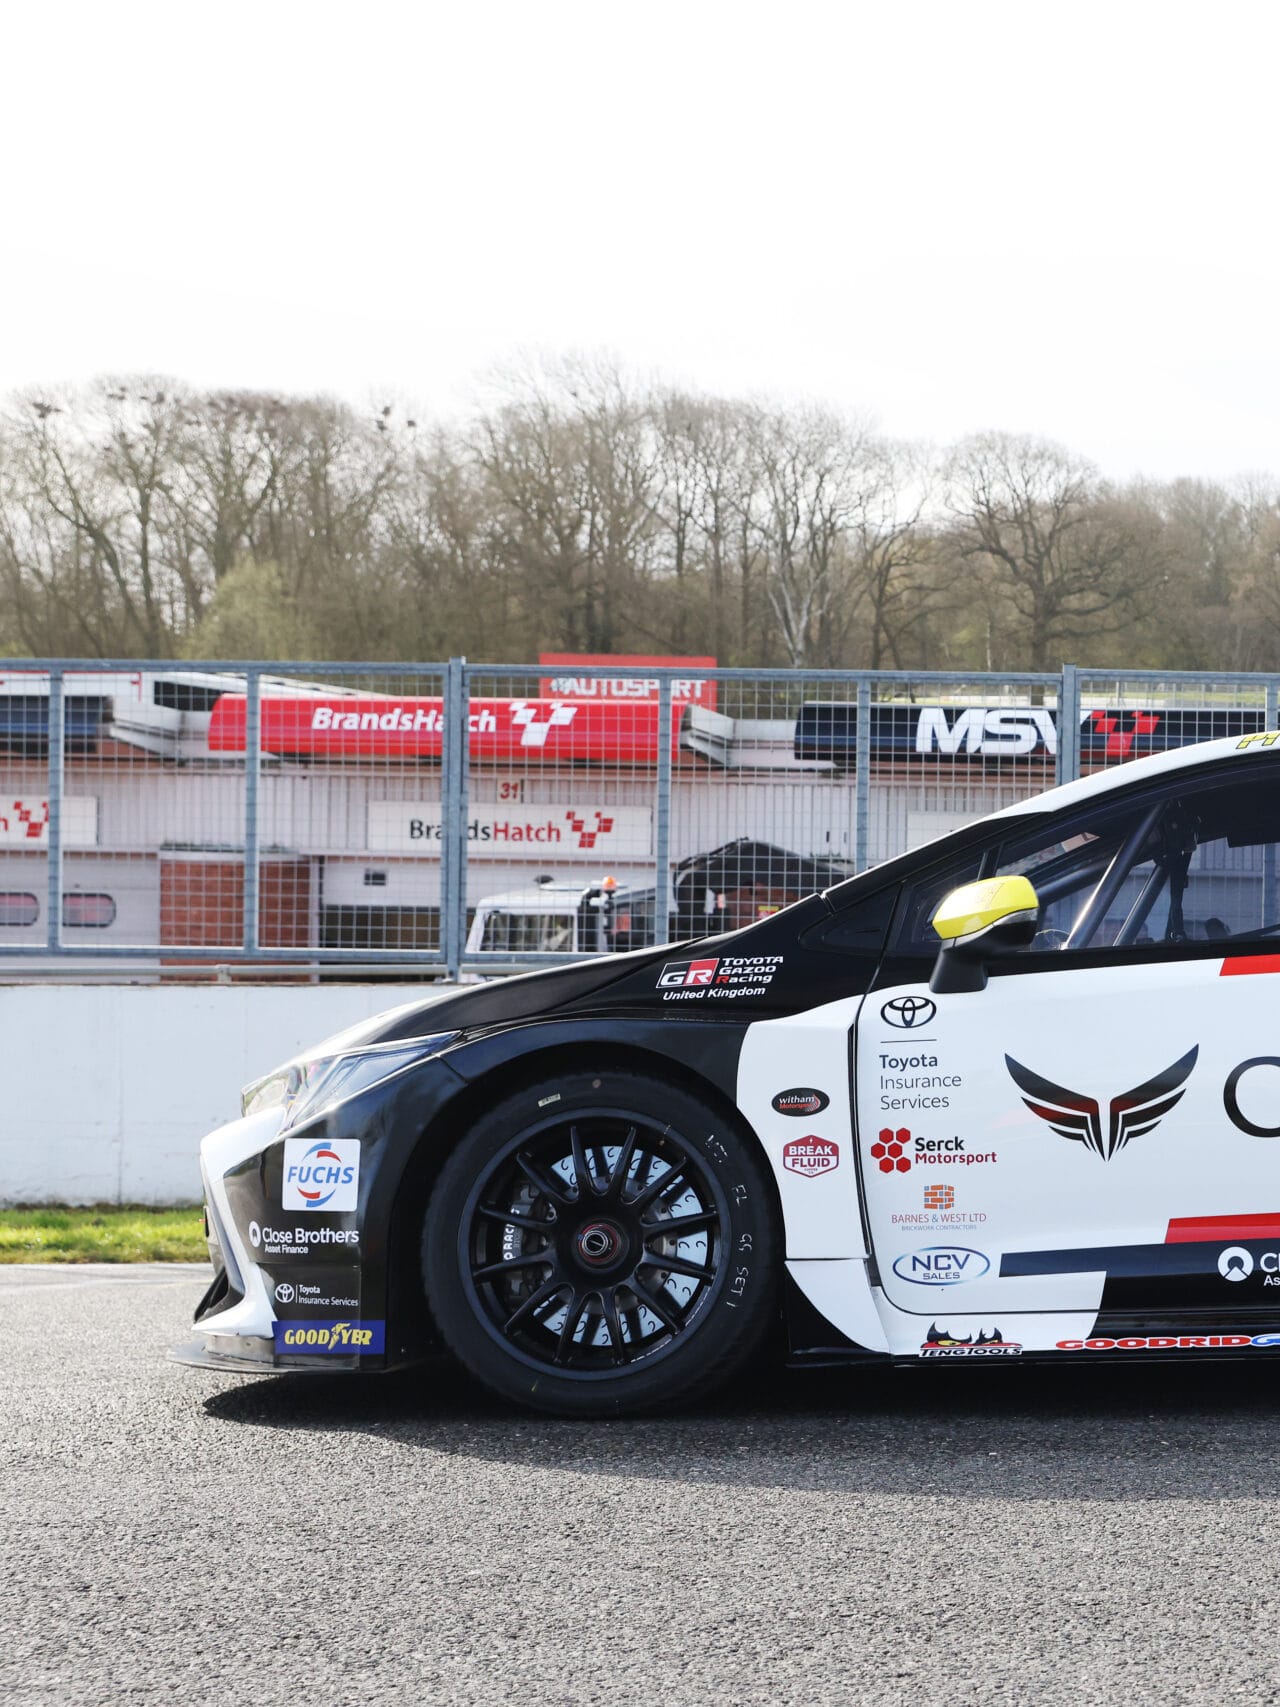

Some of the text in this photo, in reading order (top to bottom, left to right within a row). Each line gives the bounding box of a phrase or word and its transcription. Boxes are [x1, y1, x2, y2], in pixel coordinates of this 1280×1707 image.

[567, 678, 707, 698] AUTOSPRT
[721, 956, 784, 966] TOYOTA
[719, 965, 777, 975] GAZOO
[660, 969, 713, 986] GR
[715, 973, 773, 984] Racing
[663, 986, 766, 1000] United Kingdom
[879, 1054, 938, 1072] Toyota
[880, 1075, 962, 1090] Insurance
[880, 1094, 950, 1110] Services
[789, 1145, 833, 1155] BREAK
[914, 1136, 965, 1152] Serck
[791, 1157, 831, 1168] FLUID
[915, 1152, 997, 1165] Motorsport
[287, 1166, 355, 1184] FUCHS
[891, 1213, 987, 1223] BARNES & WEST LTD
[262, 1227, 360, 1244] Close Brothers
[282, 1244, 309, 1254] Finance
[912, 1253, 971, 1271] NCV
[922, 1272, 961, 1281] SALES
[299, 1284, 321, 1295] Toyota
[298, 1296, 359, 1306] Insurance Services
